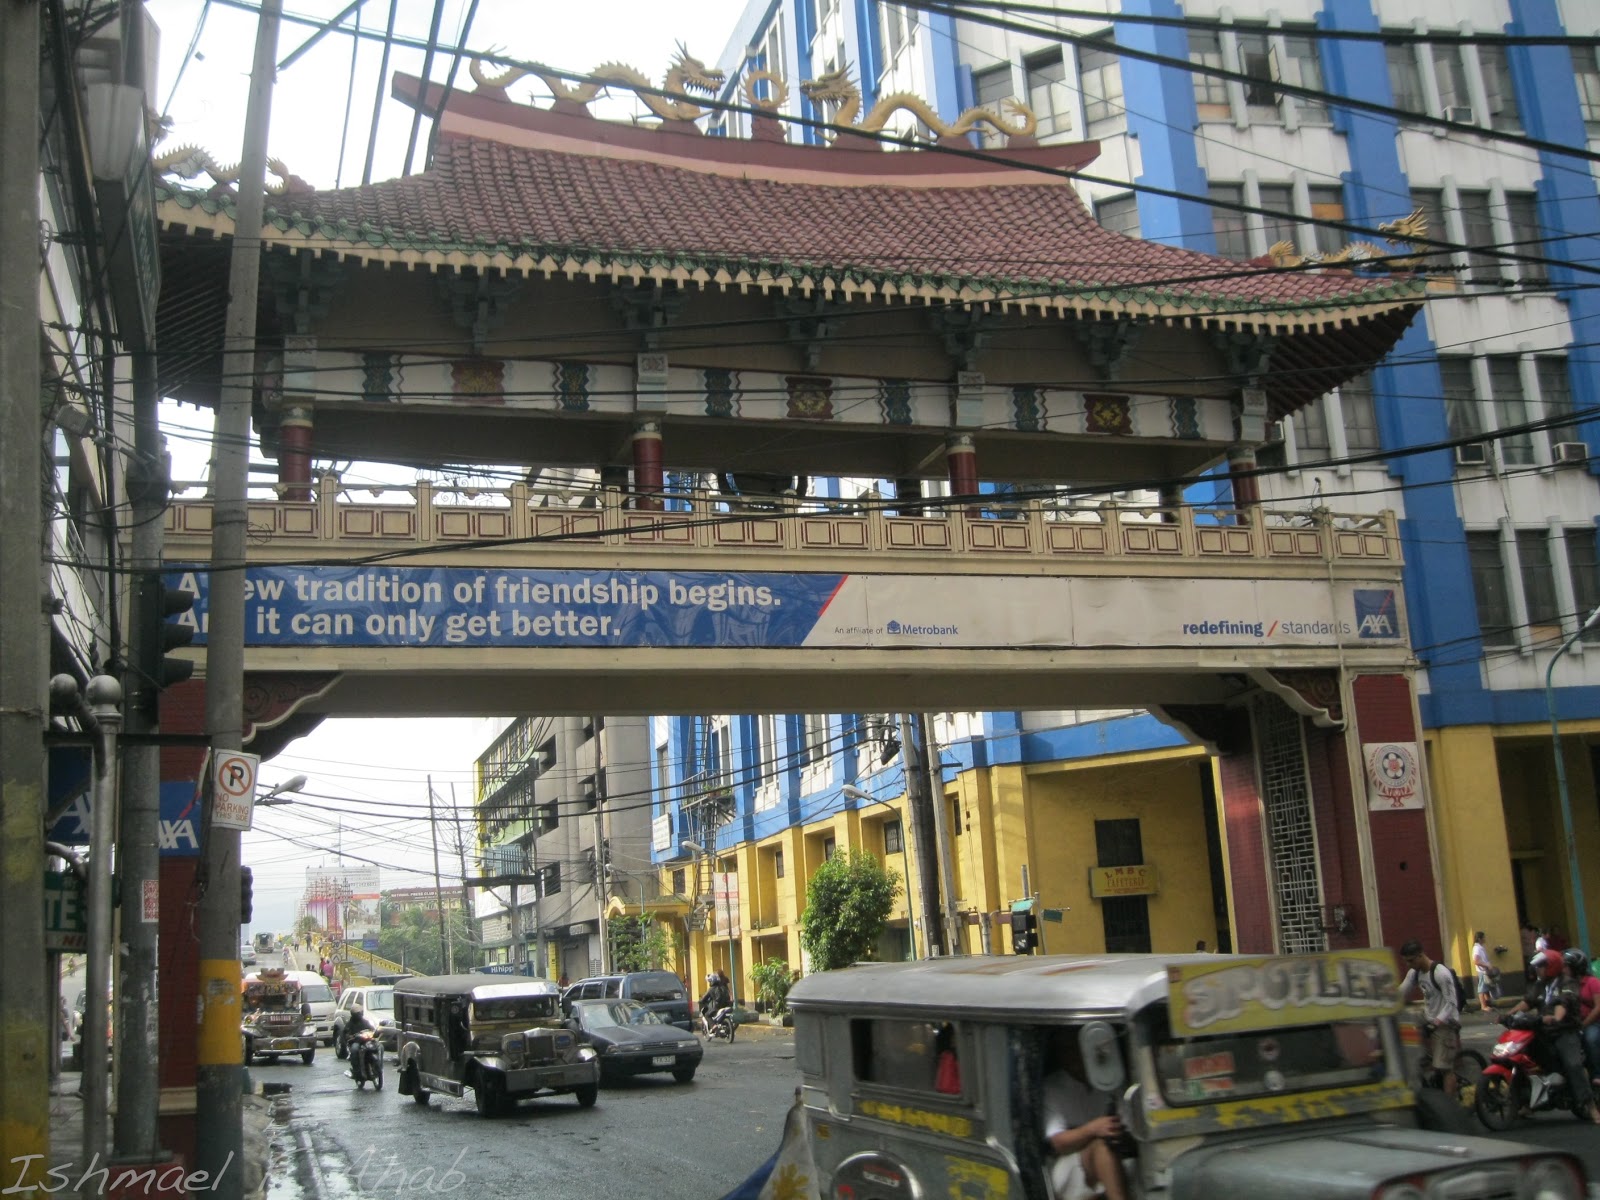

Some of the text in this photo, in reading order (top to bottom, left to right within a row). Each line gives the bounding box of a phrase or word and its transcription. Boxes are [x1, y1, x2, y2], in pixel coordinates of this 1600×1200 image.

[178, 572, 781, 612] A ew tradition of friendship begins.
[256, 606, 621, 643] it can only get better.
[834, 626, 844, 634] An
[875, 627, 884, 635] of
[902, 624, 959, 635] Metrobank
[1182, 620, 1264, 638] redefining
[1281, 621, 1351, 636] standards
[1358, 613, 1394, 635] AXA
[216, 792, 229, 802] NO
[216, 802, 249, 815] PARKING
[158, 819, 200, 849] XA
